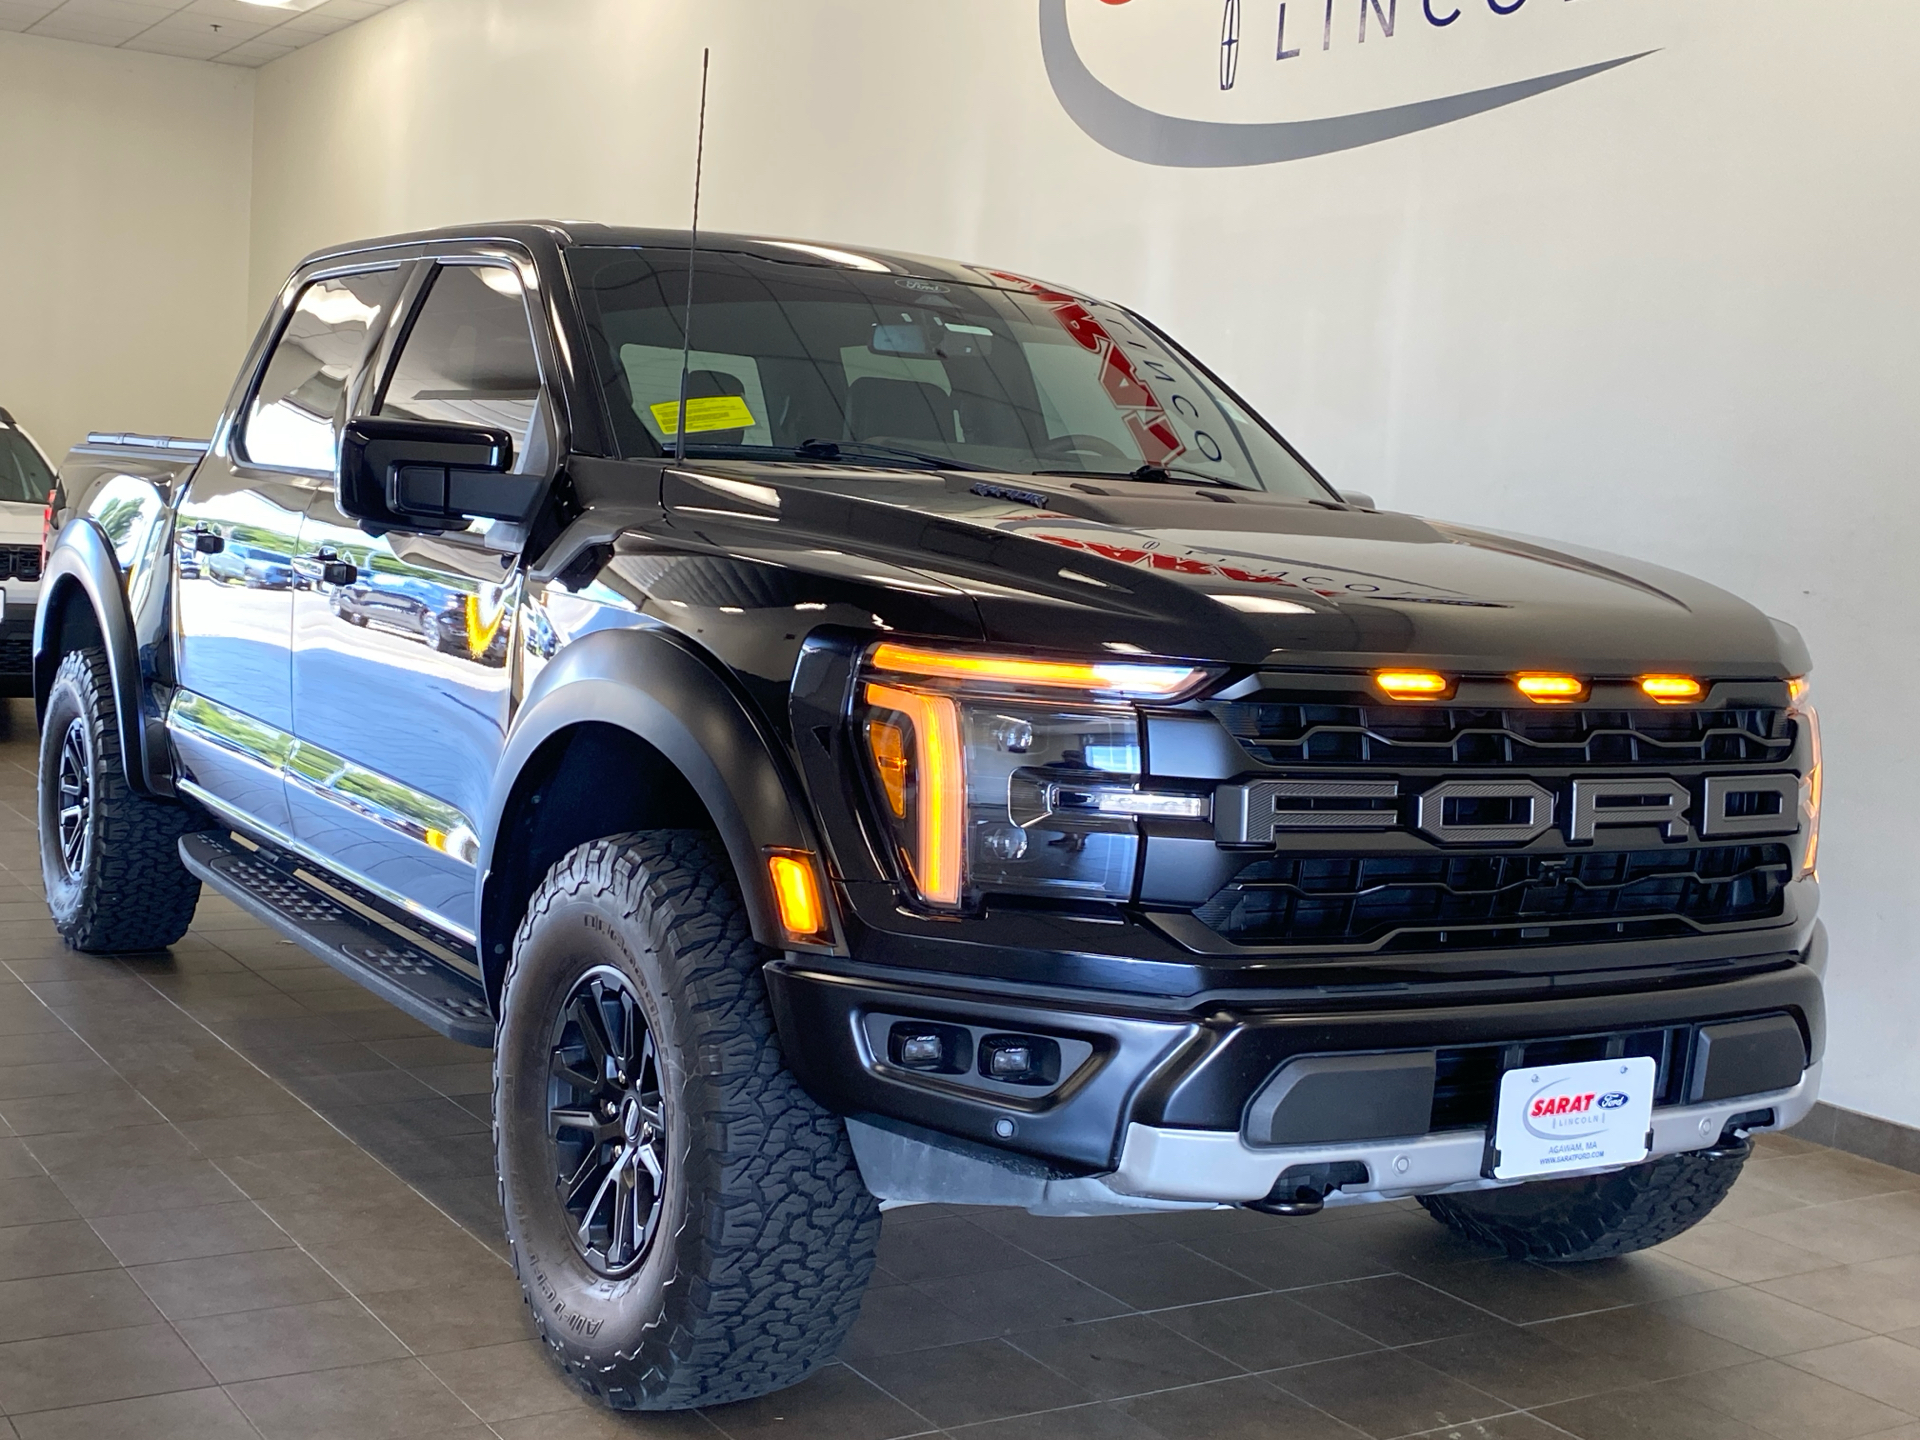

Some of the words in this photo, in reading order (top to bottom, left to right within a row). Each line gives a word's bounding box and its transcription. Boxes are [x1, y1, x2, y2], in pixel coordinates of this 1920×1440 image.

[1240, 773, 1800, 844] FORD
[1531, 1093, 1596, 1118] SARAT
[1600, 1093, 1626, 1109] Ford
[1558, 1114, 1600, 1128] LINCOLN
[1585, 1141, 1598, 1151] MA
[1539, 1151, 1605, 1166] WWW.SARATFORD.COM
